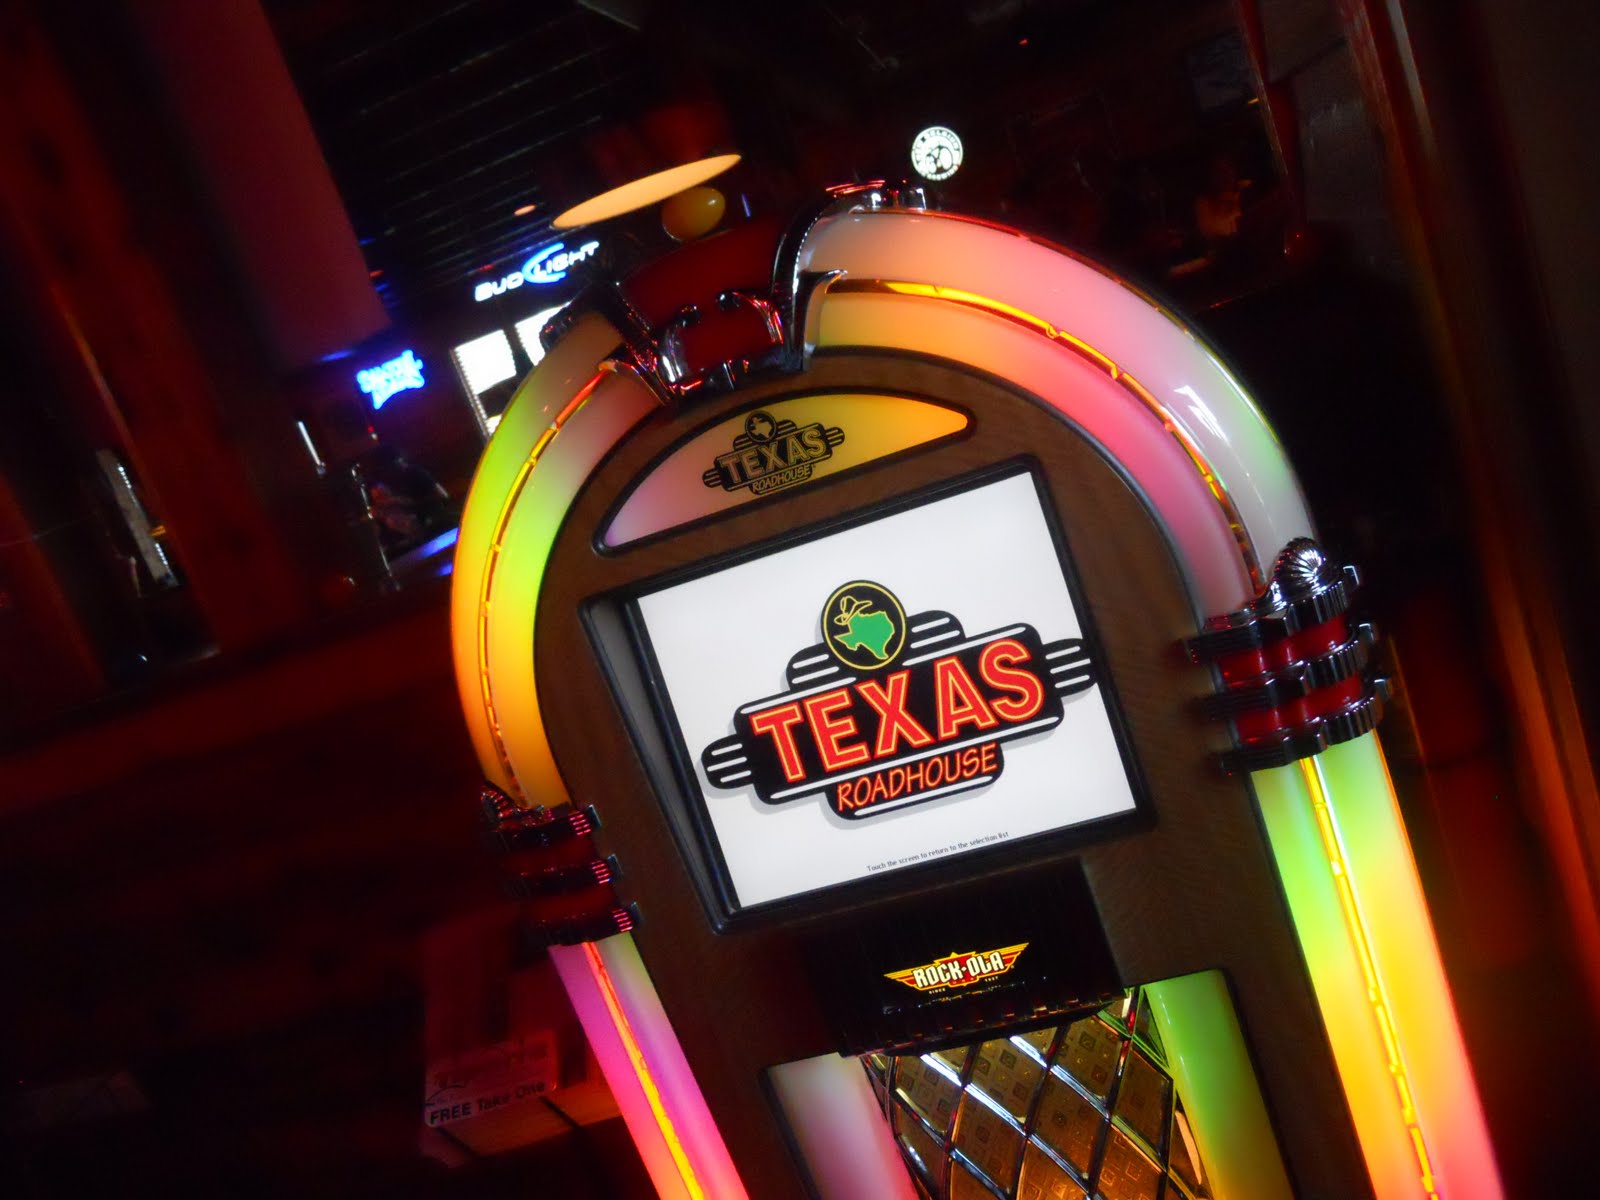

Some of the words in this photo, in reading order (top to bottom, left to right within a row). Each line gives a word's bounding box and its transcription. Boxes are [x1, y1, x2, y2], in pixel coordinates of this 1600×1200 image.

[474, 271, 524, 302] BUD
[533, 240, 600, 280] LIGHT
[719, 428, 827, 485] TEXAS
[752, 464, 812, 493] ROADHOUSE
[749, 637, 1045, 784] TEXAS
[836, 742, 999, 812] ROADHOUSE
[866, 862, 887, 873] Touch
[887, 860, 898, 868] the
[898, 854, 920, 865] screen
[920, 852, 928, 860] to
[928, 846, 949, 857] return
[949, 844, 957, 852] to
[957, 841, 968, 850] the
[969, 832, 998, 847] selection
[998, 830, 1009, 840] list
[430, 1102, 473, 1124] FREE
[515, 1081, 546, 1099] One
